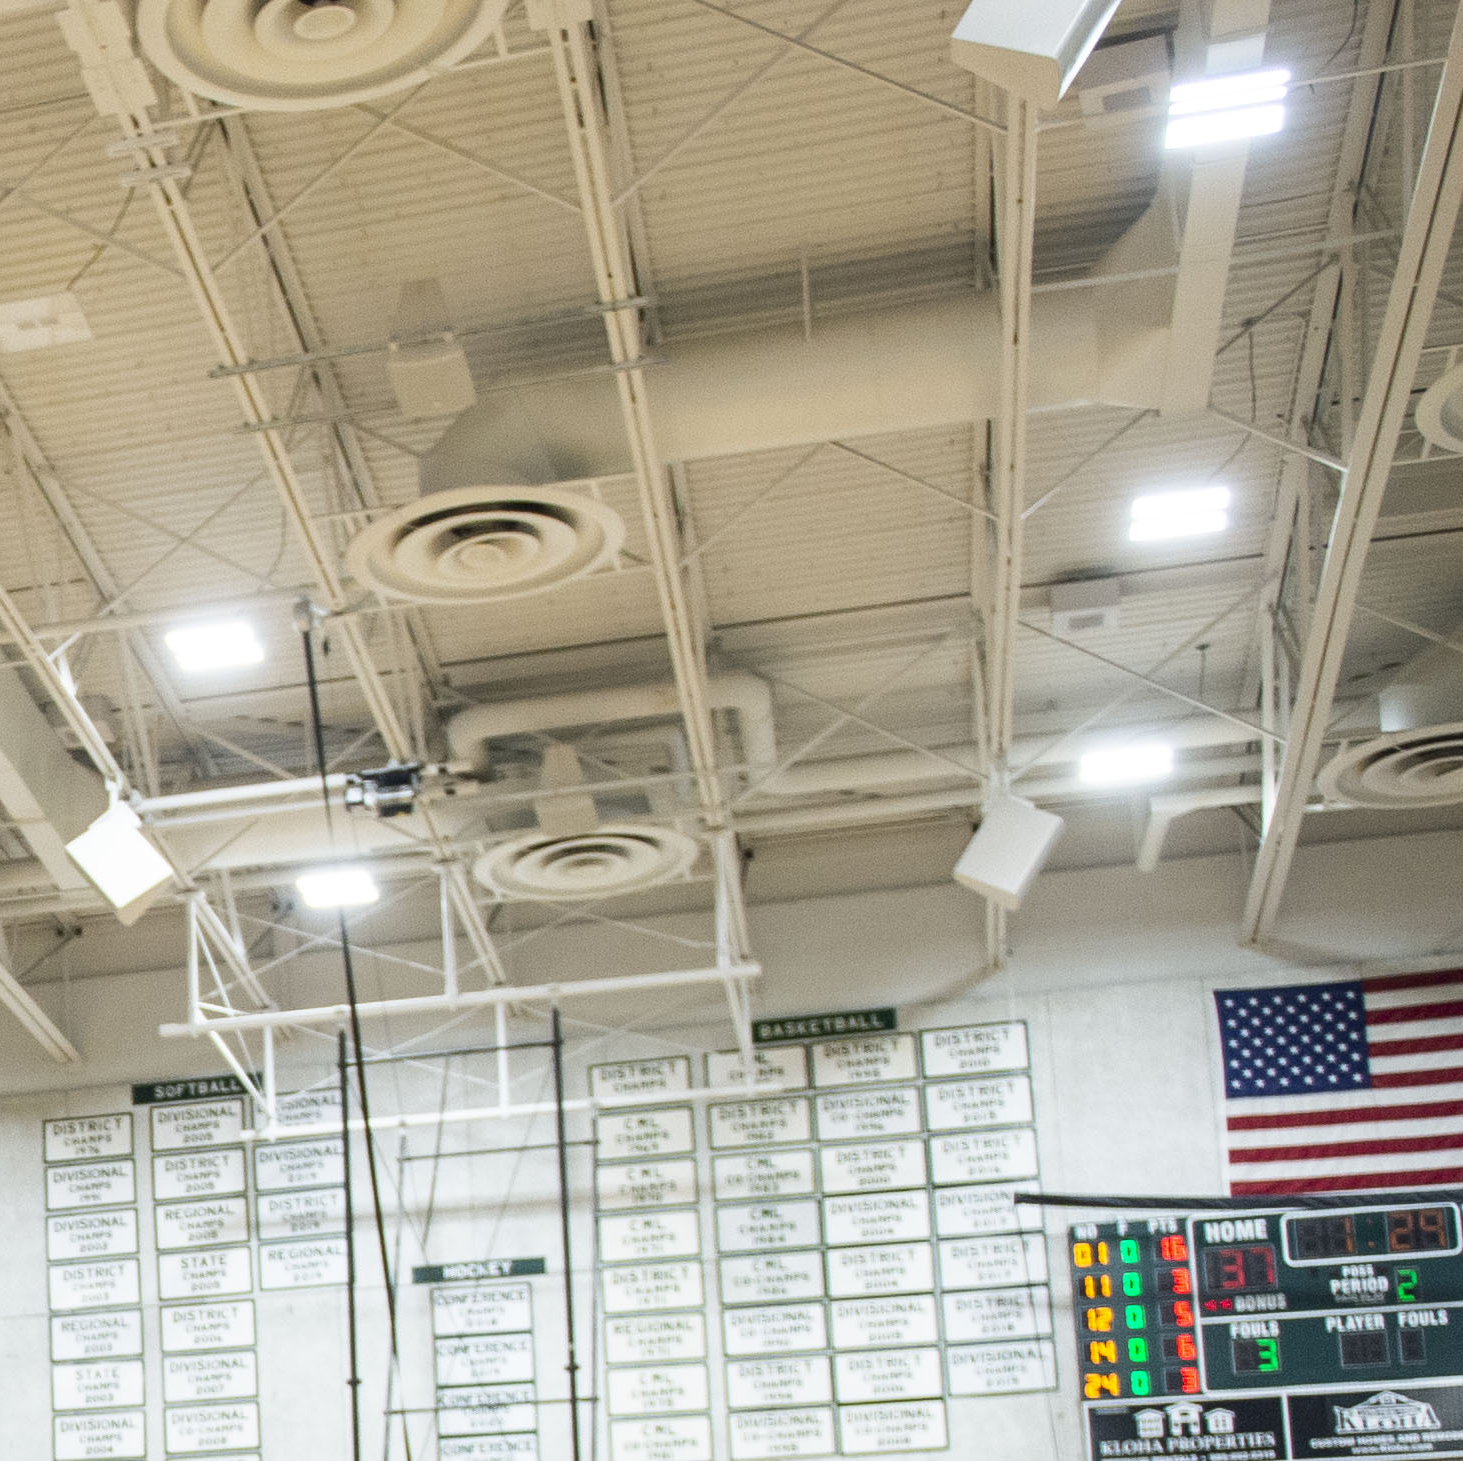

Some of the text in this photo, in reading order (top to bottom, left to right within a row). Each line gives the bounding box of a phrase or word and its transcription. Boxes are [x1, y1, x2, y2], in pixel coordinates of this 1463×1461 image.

[759, 1014, 884, 1039] BASKETBALL
[154, 1081, 240, 1098] SOFTBALL
[157, 1106, 236, 1123] DIVISIONAL
[53, 1118, 122, 1135] DISTRICT
[175, 1120, 220, 1132] CHAMPS
[64, 1134, 112, 1146] CHAMPS
[260, 1145, 341, 1163] DIVISIONAL
[165, 1155, 229, 1172] DISTRICT
[280, 1162, 324, 1173] CHAMPS
[53, 1166, 127, 1182] DIVISIONAL
[177, 1170, 221, 1182] CHAMPS
[69, 1182, 112, 1193] CHAMPS
[269, 1194, 337, 1211] DISTRICT
[165, 1204, 234, 1219] REGIONAL
[54, 1216, 126, 1232] DIVISIONAL
[179, 1219, 225, 1231] CHAMPS
[1204, 1219, 1268, 1243] HOME
[70, 1231, 112, 1242] CHAMPS
[268, 1244, 341, 1260] REGIONAL
[1120, 1240, 1139, 1263] 0
[181, 1254, 227, 1268] STATE
[285, 1261, 328, 1270] CHAMPS
[1220, 1247, 1274, 1289] 37
[63, 1264, 125, 1281] DISTRICT
[183, 1270, 226, 1280] CHAMPS
[74, 1280, 116, 1291] CHAMPS
[1084, 1274, 1111, 1298] 11
[1123, 1272, 1141, 1296] 0
[1330, 1276, 1388, 1295] PERIOD
[1398, 1269, 1417, 1301] 2
[173, 1307, 238, 1322] DISTRICT
[1125, 1305, 1145, 1329] 0
[1325, 1309, 1448, 1333] PLAYER FOULS
[61, 1317, 129, 1331] REGIONAL
[186, 1322, 230, 1333] CHAMPS
[1230, 1320, 1279, 1339] FOULS
[76, 1332, 118, 1343] CHAMPS
[1128, 1338, 1147, 1362] 0
[1256, 1339, 1278, 1372] 3
[76, 1367, 120, 1380] STATE
[170, 1359, 247, 1373] DIVISIONAL
[188, 1374, 232, 1383] CHAMPS
[1130, 1371, 1150, 1396] 0
[78, 1382, 120, 1392] CHAMPS
[172, 1409, 247, 1423] DIVISIONAL
[60, 1418, 136, 1432] DIVISIONAL
[79, 1432, 122, 1443] CHAMPS
[1167, 1432, 1275, 1452] PROPERTIES
